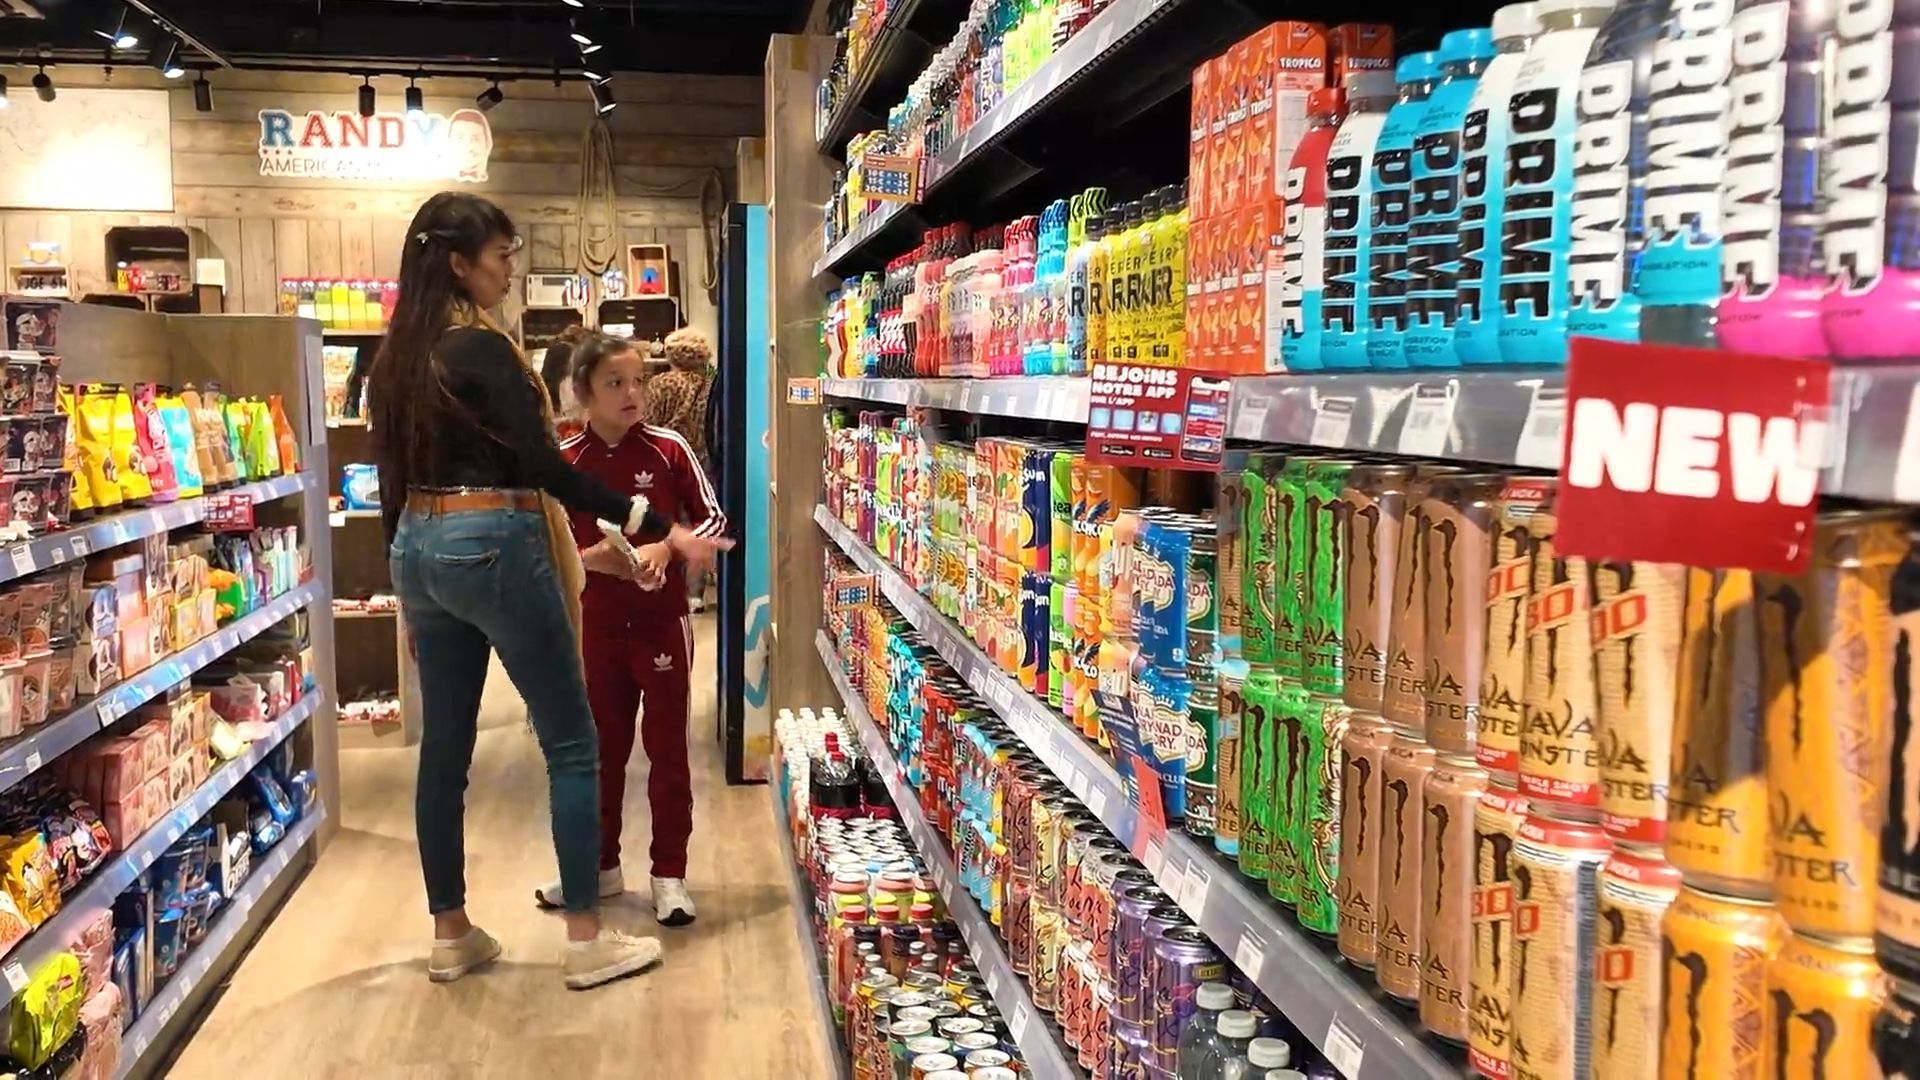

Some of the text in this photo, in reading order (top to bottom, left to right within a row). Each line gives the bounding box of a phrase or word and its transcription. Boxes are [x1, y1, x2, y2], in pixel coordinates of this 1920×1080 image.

[1280, 57, 1322, 69] TROPICO
[1347, 58, 1390, 69] TROPICO
[261, 112, 441, 148] RANDY
[1641, 0, 1735, 249] PRIME
[1408, 131, 1460, 329] PRIME
[1501, 88, 1560, 319] PRIME
[1569, 60, 1634, 312] PRIME
[1092, 381, 1176, 399] NOTRE APP
[1568, 397, 1821, 508] NEW
